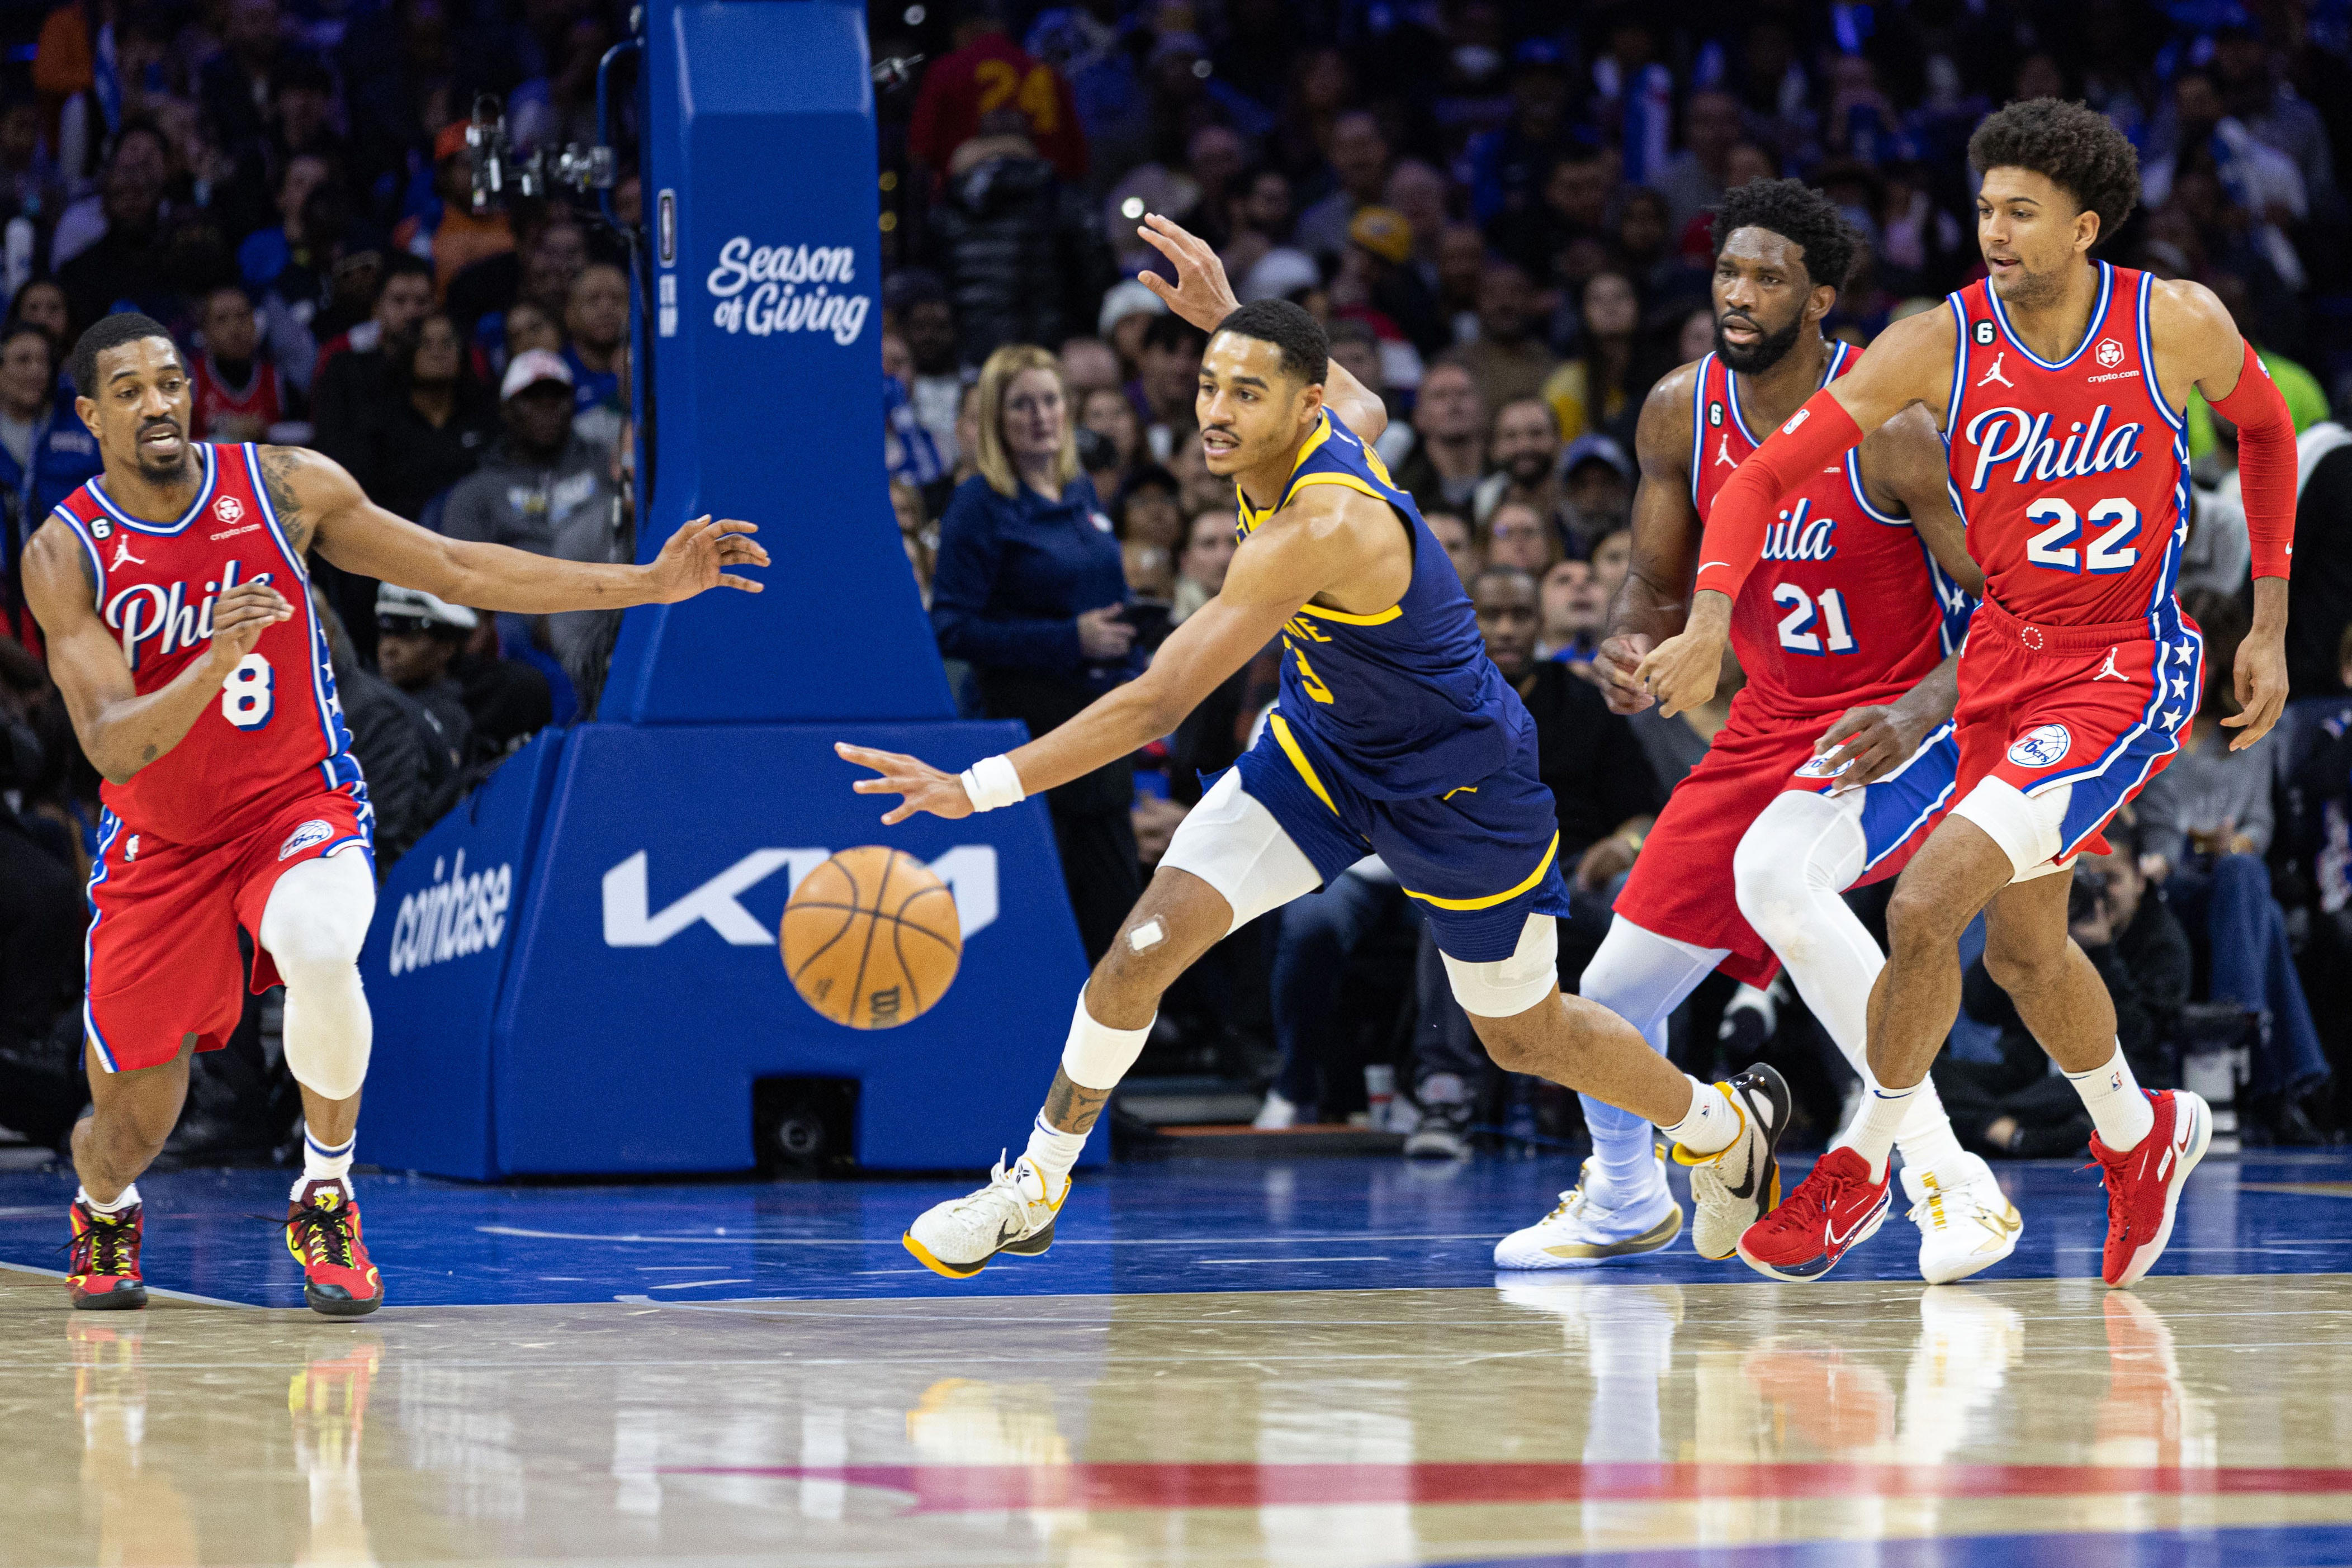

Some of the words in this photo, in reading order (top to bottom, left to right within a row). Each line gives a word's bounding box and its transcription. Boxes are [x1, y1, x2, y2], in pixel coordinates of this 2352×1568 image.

[707, 236, 855, 297] Season
[713, 295, 744, 335] of
[745, 282, 870, 346] Giving
[1977, 323, 1993, 343] 6
[2088, 370, 2140, 383] crypto.com
[1710, 404, 1722, 425] 6
[1966, 404, 2144, 493] Phila
[91, 519, 111, 538] 6
[210, 523, 262, 541] crypto.com
[2026, 497, 2142, 575] 22
[1772, 582, 1860, 657] 21
[222, 653, 276, 732] 8
[2015, 736, 2050, 762] 76ers
[389, 847, 512, 977] coinbase
